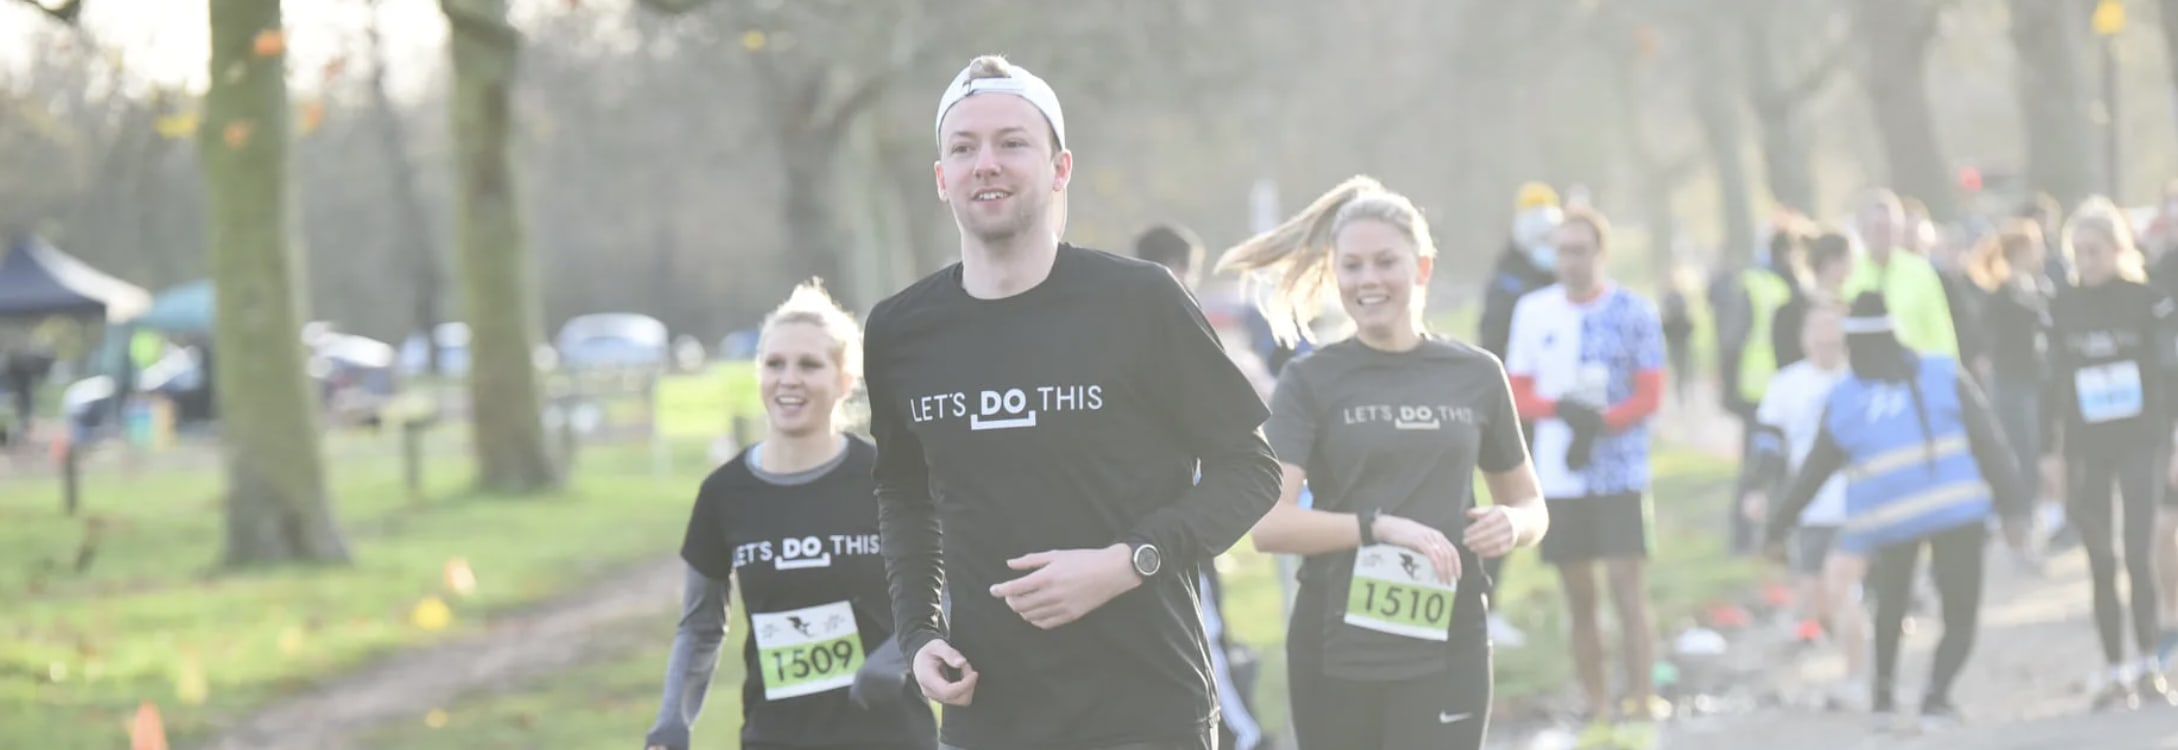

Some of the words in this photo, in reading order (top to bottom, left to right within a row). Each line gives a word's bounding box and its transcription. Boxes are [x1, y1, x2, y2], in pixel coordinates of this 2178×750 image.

[910, 391, 967, 423] LET'S
[980, 388, 1027, 416] DO
[1036, 385, 1104, 412] THIS
[1343, 404, 1393, 425] LET'S
[1399, 405, 1433, 421] DO
[782, 535, 822, 558] DO
[829, 533, 881, 556] THIS
[1365, 582, 1444, 624] 1510
[772, 639, 854, 683] 1509
